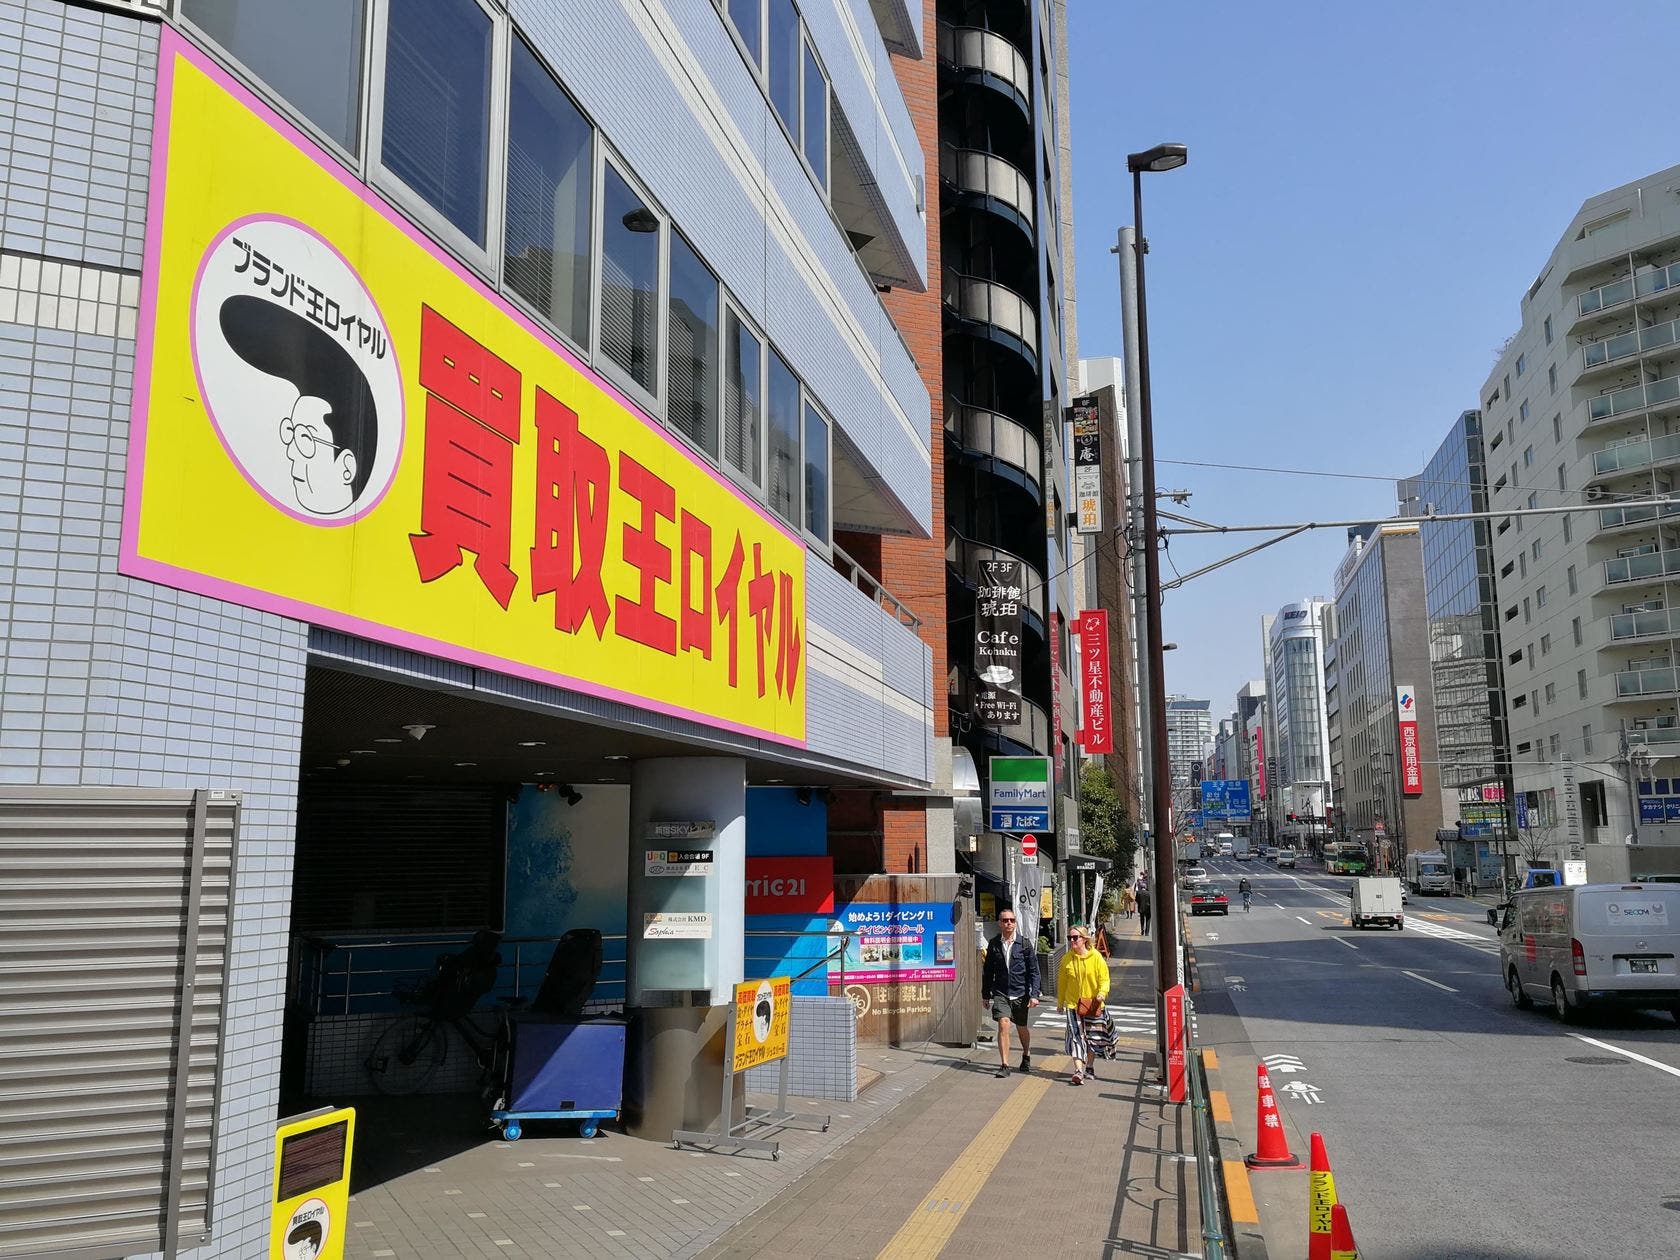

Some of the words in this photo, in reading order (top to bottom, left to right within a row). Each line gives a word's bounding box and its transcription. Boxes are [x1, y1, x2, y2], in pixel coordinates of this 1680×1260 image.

[232, 236, 387, 360] ブランド王ロイヤル
[408, 301, 801, 706] 買取王ロイヤル
[986, 561, 999, 573] 2F
[1000, 562, 1013, 573] 3F
[976, 585, 1021, 600] 珈琲館
[981, 599, 1018, 617] 琥珀
[977, 630, 1019, 645] Cafe
[979, 646, 1018, 657] Kohaku
[1086, 632, 1106, 746] 三ツ星不動産ビル
[980, 701, 996, 709] Free
[987, 710, 1021, 720] あります
[1403, 726, 1420, 787] 西京信用金庫
[993, 788, 1047, 801] FamilyMart
[1000, 814, 1013, 828] 酒
[1015, 815, 1041, 828] たばこ
[1623, 908, 1650, 916] SECOM
[872, 984, 931, 1003] 駐輪禁止
[872, 1008, 882, 1016] No
[882, 1007, 906, 1015] Bicycle
[906, 1006, 932, 1014] Parking
